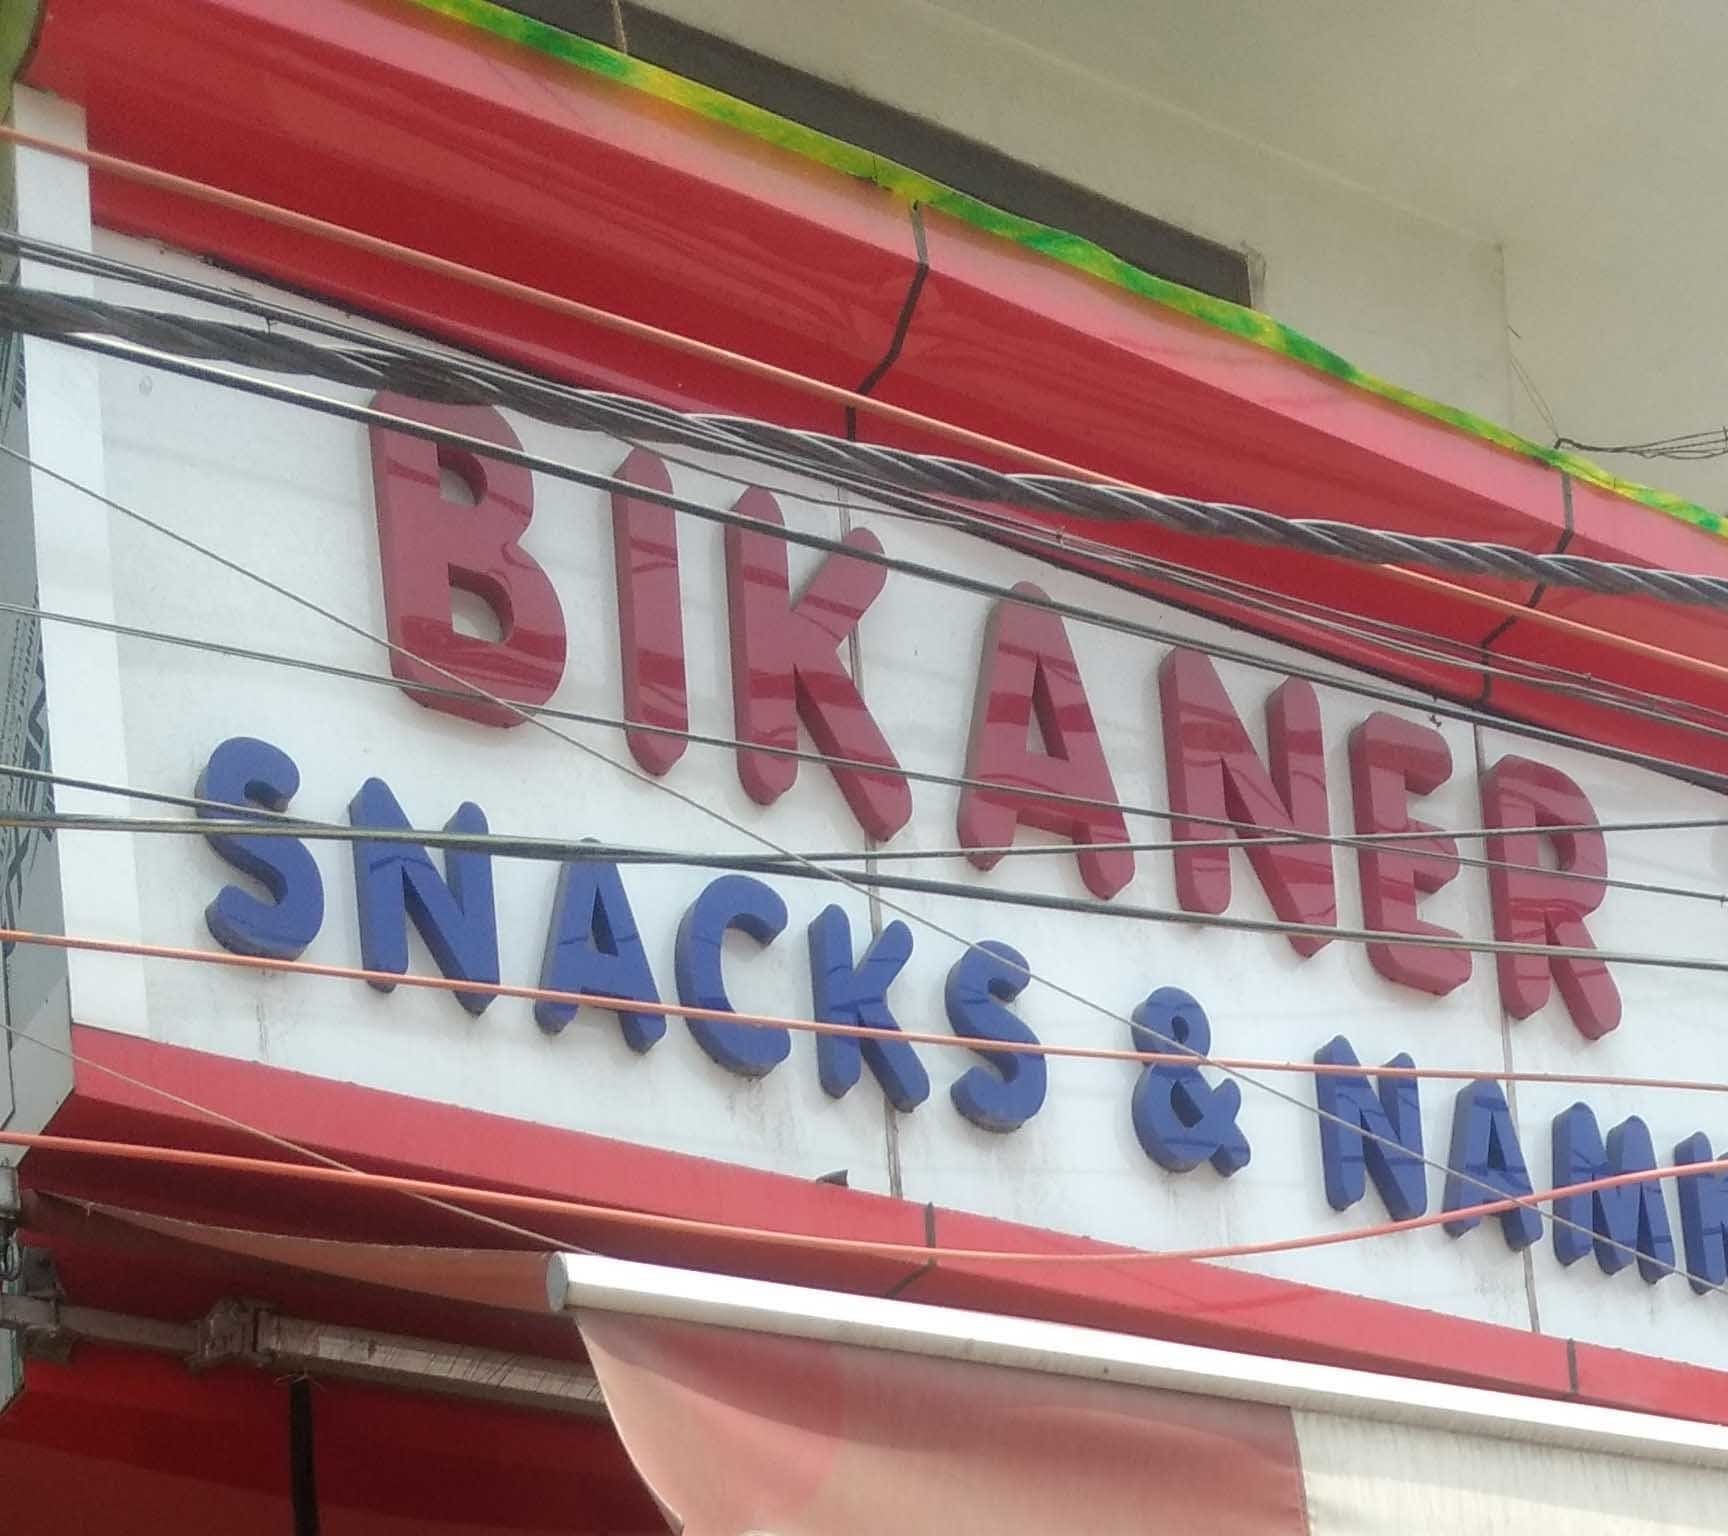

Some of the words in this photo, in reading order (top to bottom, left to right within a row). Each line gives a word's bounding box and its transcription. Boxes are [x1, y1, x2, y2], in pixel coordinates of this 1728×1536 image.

[196, 736, 1048, 1134] SNACKS
[1131, 986, 1250, 1178] &
[368, 388, 1622, 1040] BIKANER
